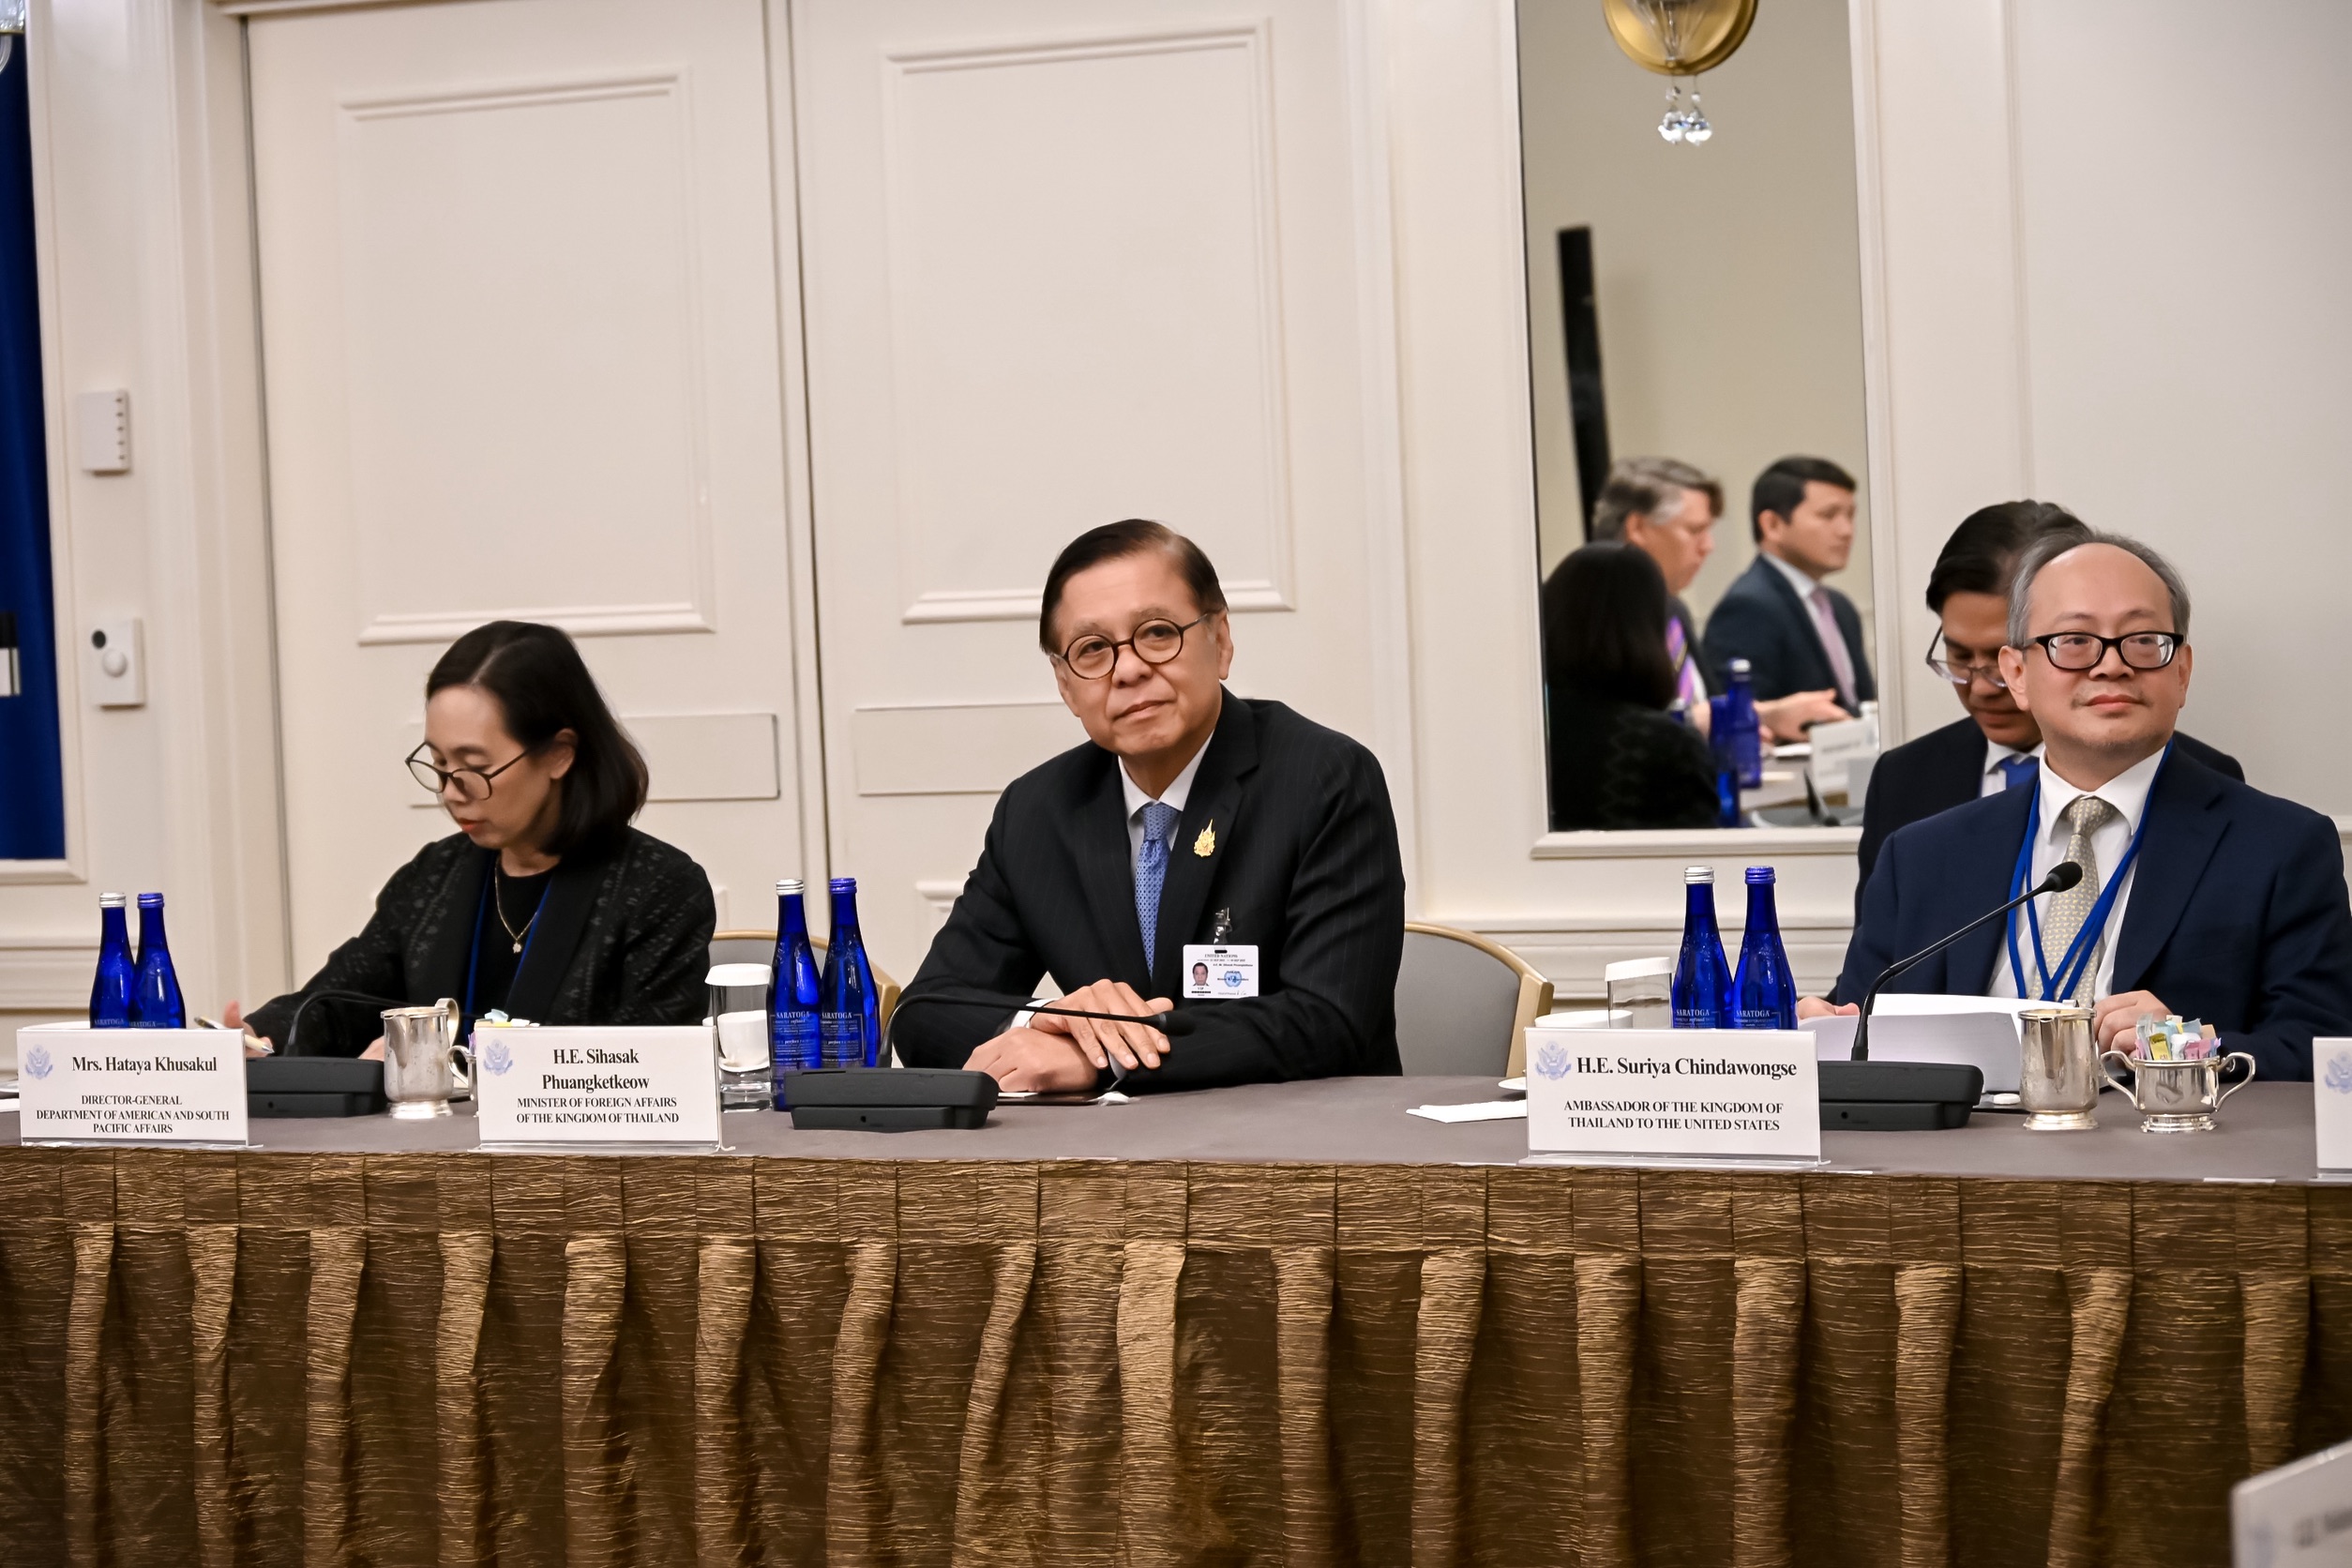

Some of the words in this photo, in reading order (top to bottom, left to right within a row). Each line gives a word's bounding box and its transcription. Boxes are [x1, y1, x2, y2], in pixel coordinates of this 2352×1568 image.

[776, 1011, 810, 1019] SARATOGA
[553, 1048, 583, 1064] H.E.
[586, 1048, 640, 1063] Sihasak
[72, 1057, 102, 1071] Mrs.
[105, 1057, 151, 1075] Hataya
[155, 1057, 217, 1071] Khusakul
[1576, 1057, 1613, 1074] H.E.
[1617, 1058, 1671, 1078] Suriya
[1674, 1058, 1797, 1080] Chindawongse
[542, 1075, 650, 1093] Phuangketkeow
[82, 1095, 182, 1105] DIRECTOR-GENERAL
[518, 1097, 567, 1108] MINISTER
[569, 1098, 583, 1108] OF
[585, 1098, 631, 1108] FOREIGN
[634, 1097, 677, 1108] AFFAIRS
[1564, 1100, 1651, 1112] AMBASSADOR
[1652, 1102, 1670, 1112] OF
[1671, 1102, 1697, 1112] THE
[1700, 1102, 1763, 1113] KINGDOM
[1766, 1103, 1784, 1114] OF
[37, 1110, 102, 1120] DEPARTMENT
[104, 1110, 118, 1120] OF
[118, 1110, 172, 1120] AMERICAN
[173, 1111, 193, 1120] AND
[196, 1111, 229, 1121] SOUTH
[517, 1113, 531, 1123] OF
[532, 1113, 553, 1123] THE
[555, 1113, 607, 1123] KINGDOM
[609, 1113, 623, 1123] OF
[624, 1113, 679, 1123] THAILAND
[94, 1123, 131, 1133] PACIFIC
[133, 1123, 173, 1133] AFFAIRS
[1568, 1117, 1634, 1128] THAILAND
[1636, 1118, 1653, 1128] TO
[1655, 1118, 1681, 1129] THE
[1684, 1119, 1732, 1130] UNITED
[1734, 1120, 1780, 1131] STATES
